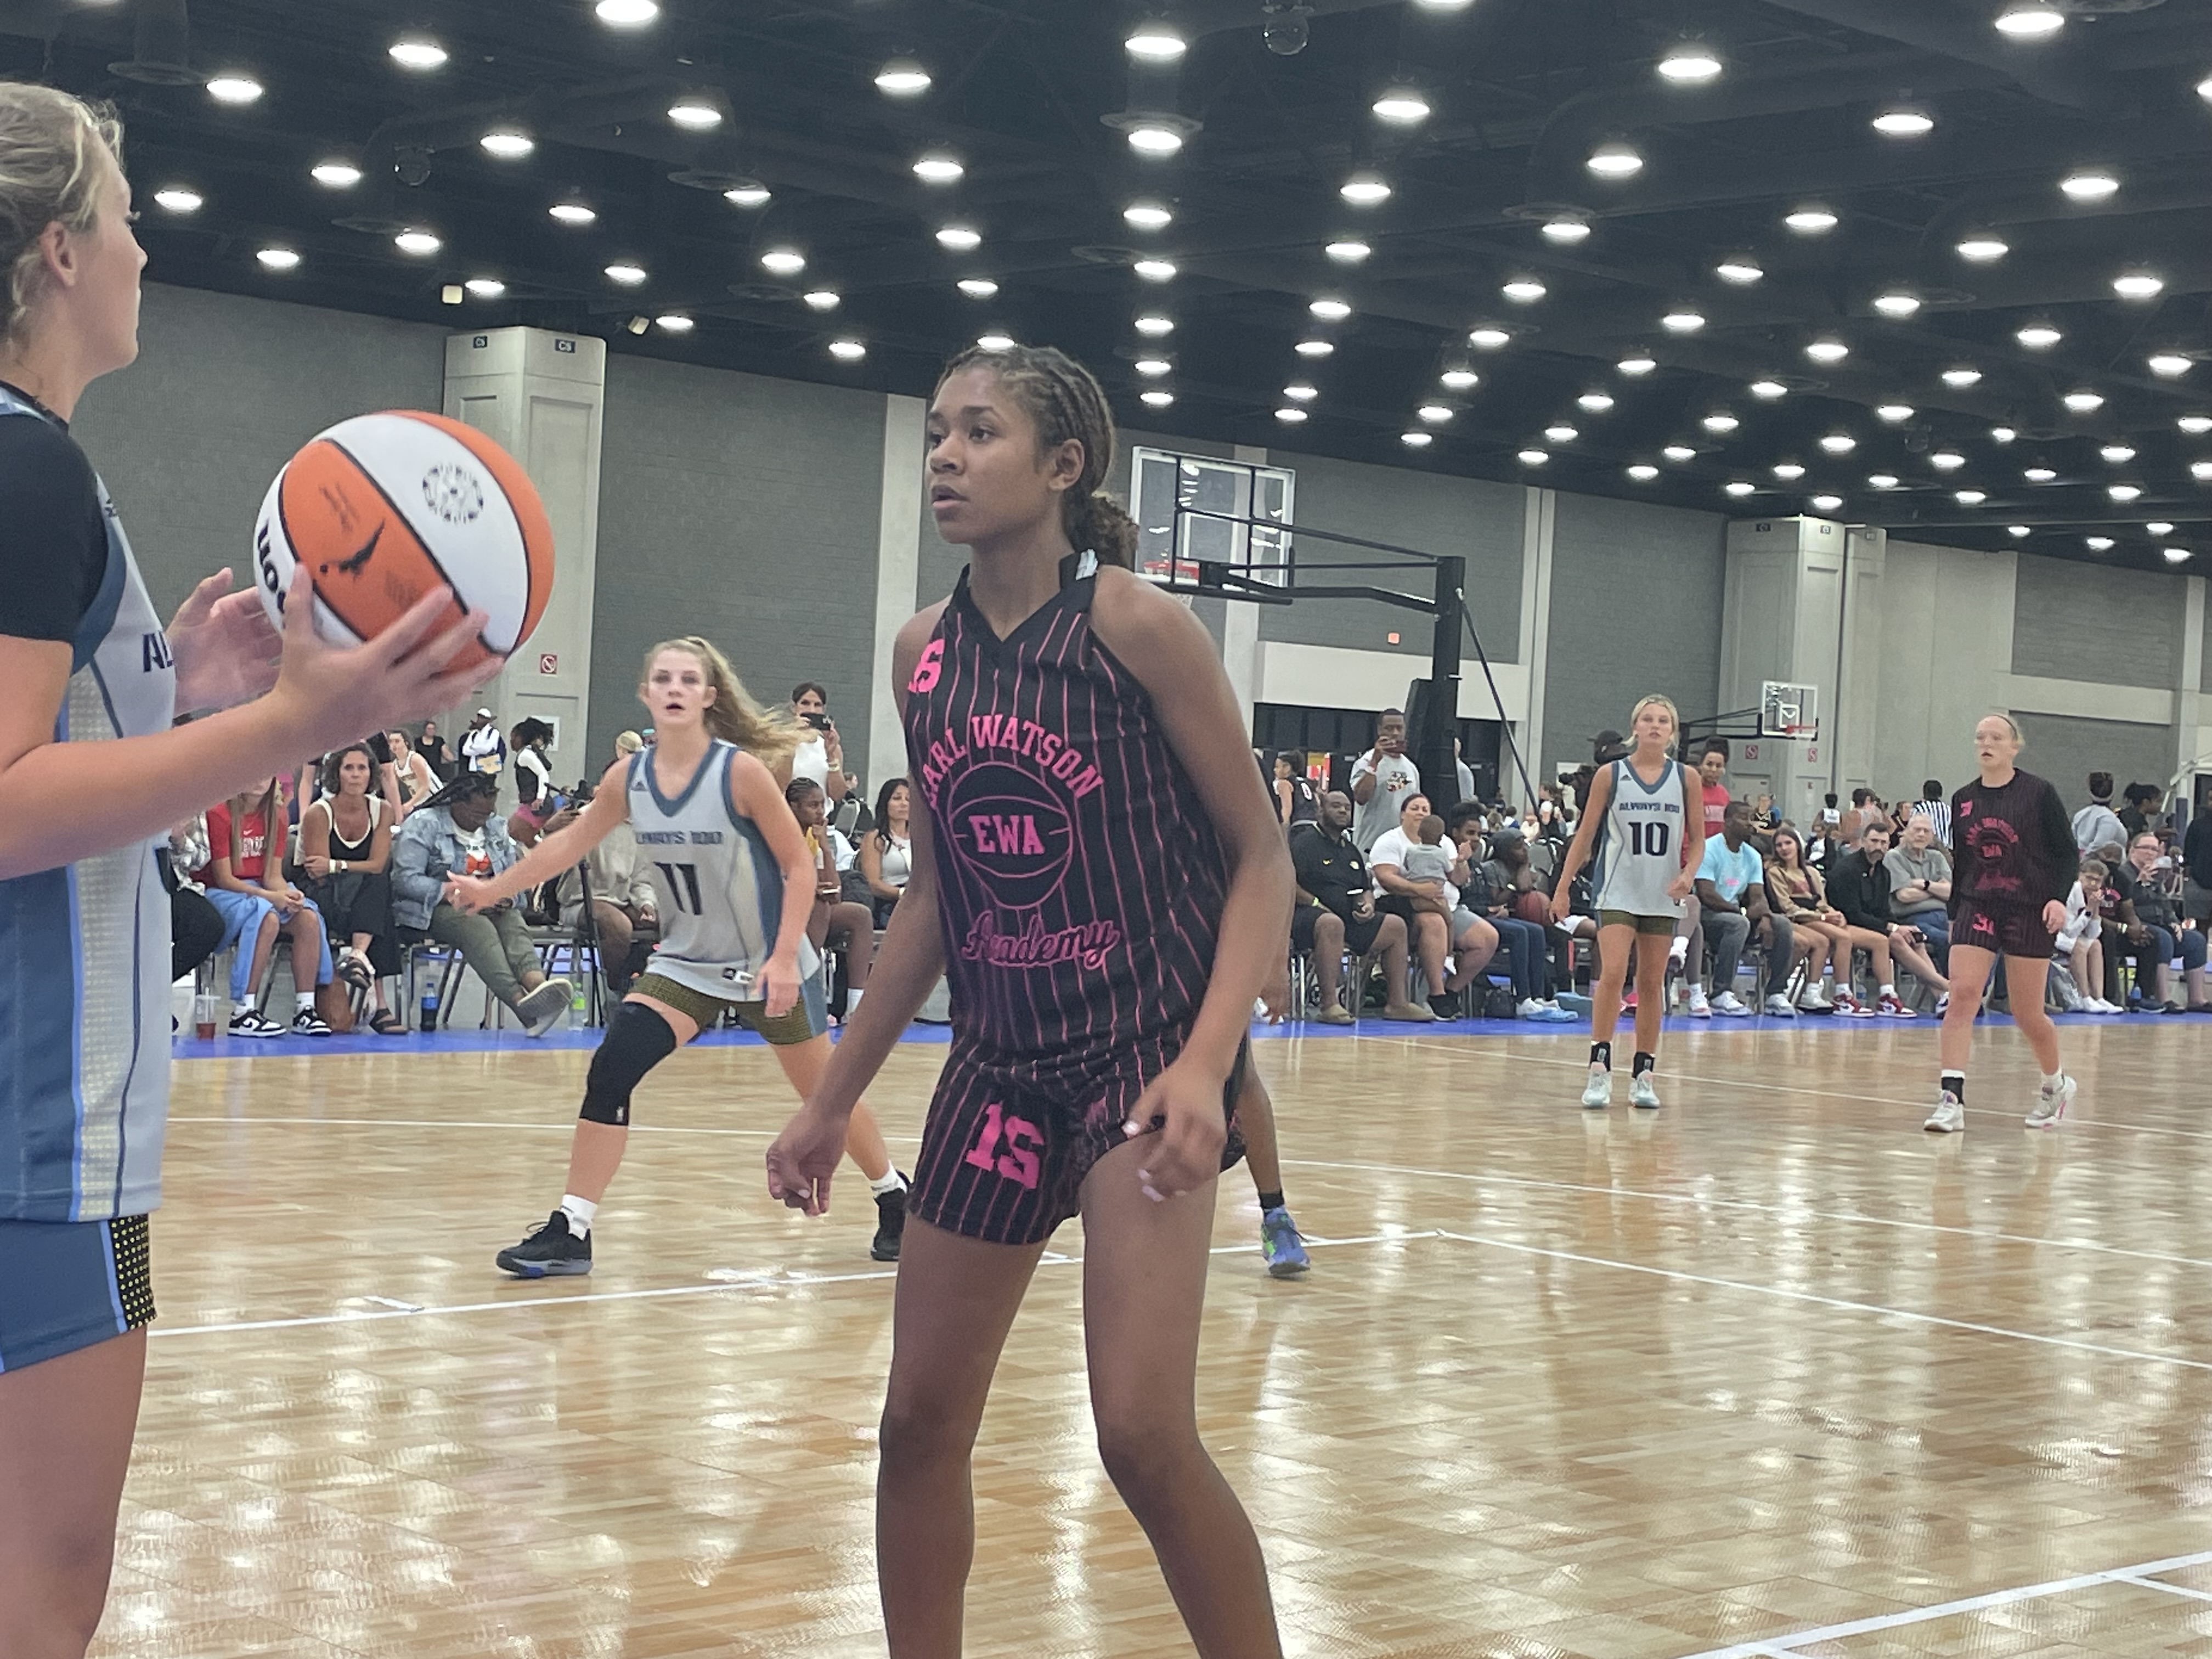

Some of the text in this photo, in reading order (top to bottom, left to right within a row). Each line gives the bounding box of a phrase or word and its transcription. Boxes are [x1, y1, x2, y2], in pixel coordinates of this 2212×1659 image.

[972, 714, 1104, 798] WATSON
[968, 814, 1045, 855] EWA
[1628, 822, 1669, 856] 10
[653, 861, 703, 916] 11
